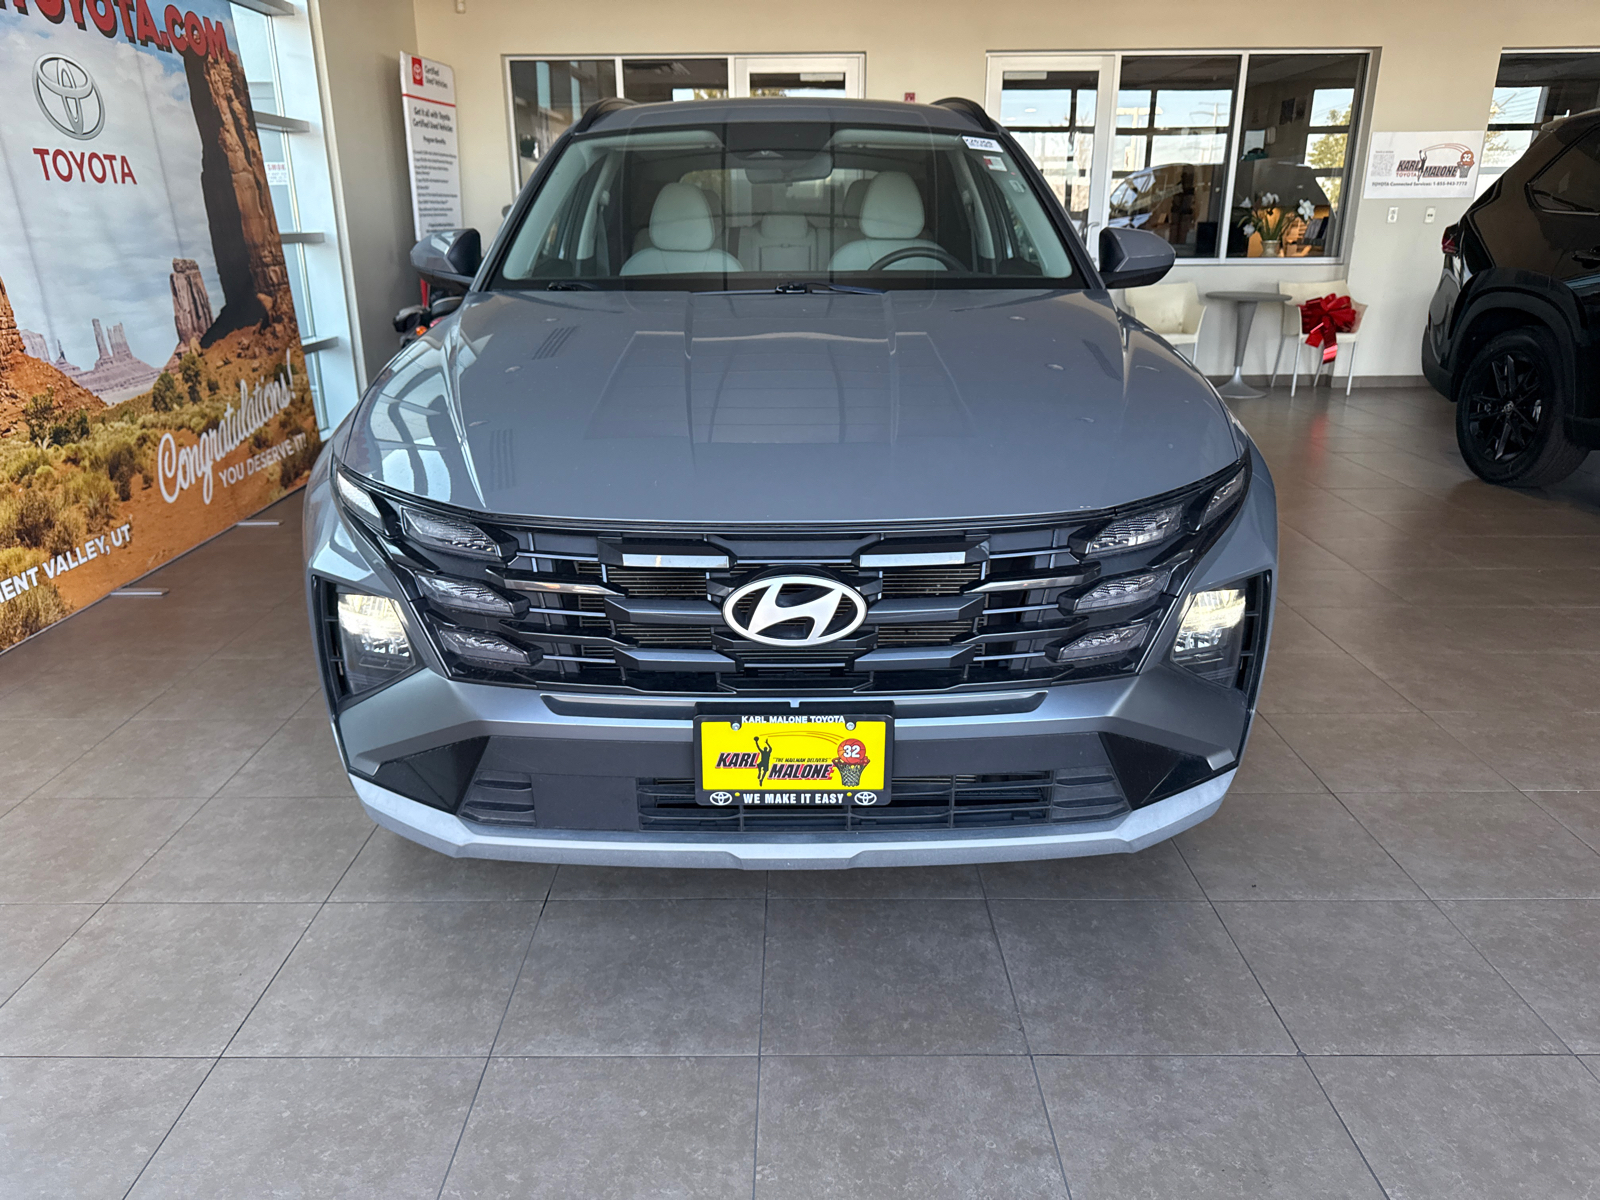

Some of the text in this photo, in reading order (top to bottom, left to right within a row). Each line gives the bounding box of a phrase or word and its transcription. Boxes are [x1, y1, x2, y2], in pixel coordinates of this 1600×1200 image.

[32, 147, 138, 185] TOYOTA
[1396, 160, 1458, 178] KARL MALONE
[1462, 153, 1471, 162] 32
[158, 348, 298, 505] Congratulations!
[219, 463, 245, 487] YOU
[246, 442, 293, 475] DESERVE
[42, 534, 110, 579] VALLEY,
[113, 523, 131, 550] UT
[741, 715, 846, 724] KARL MALONE TOYOTA
[843, 745, 860, 758] 32
[715, 752, 836, 780] KARL MALONE
[743, 793, 844, 804] WE MAKE IT EASY
